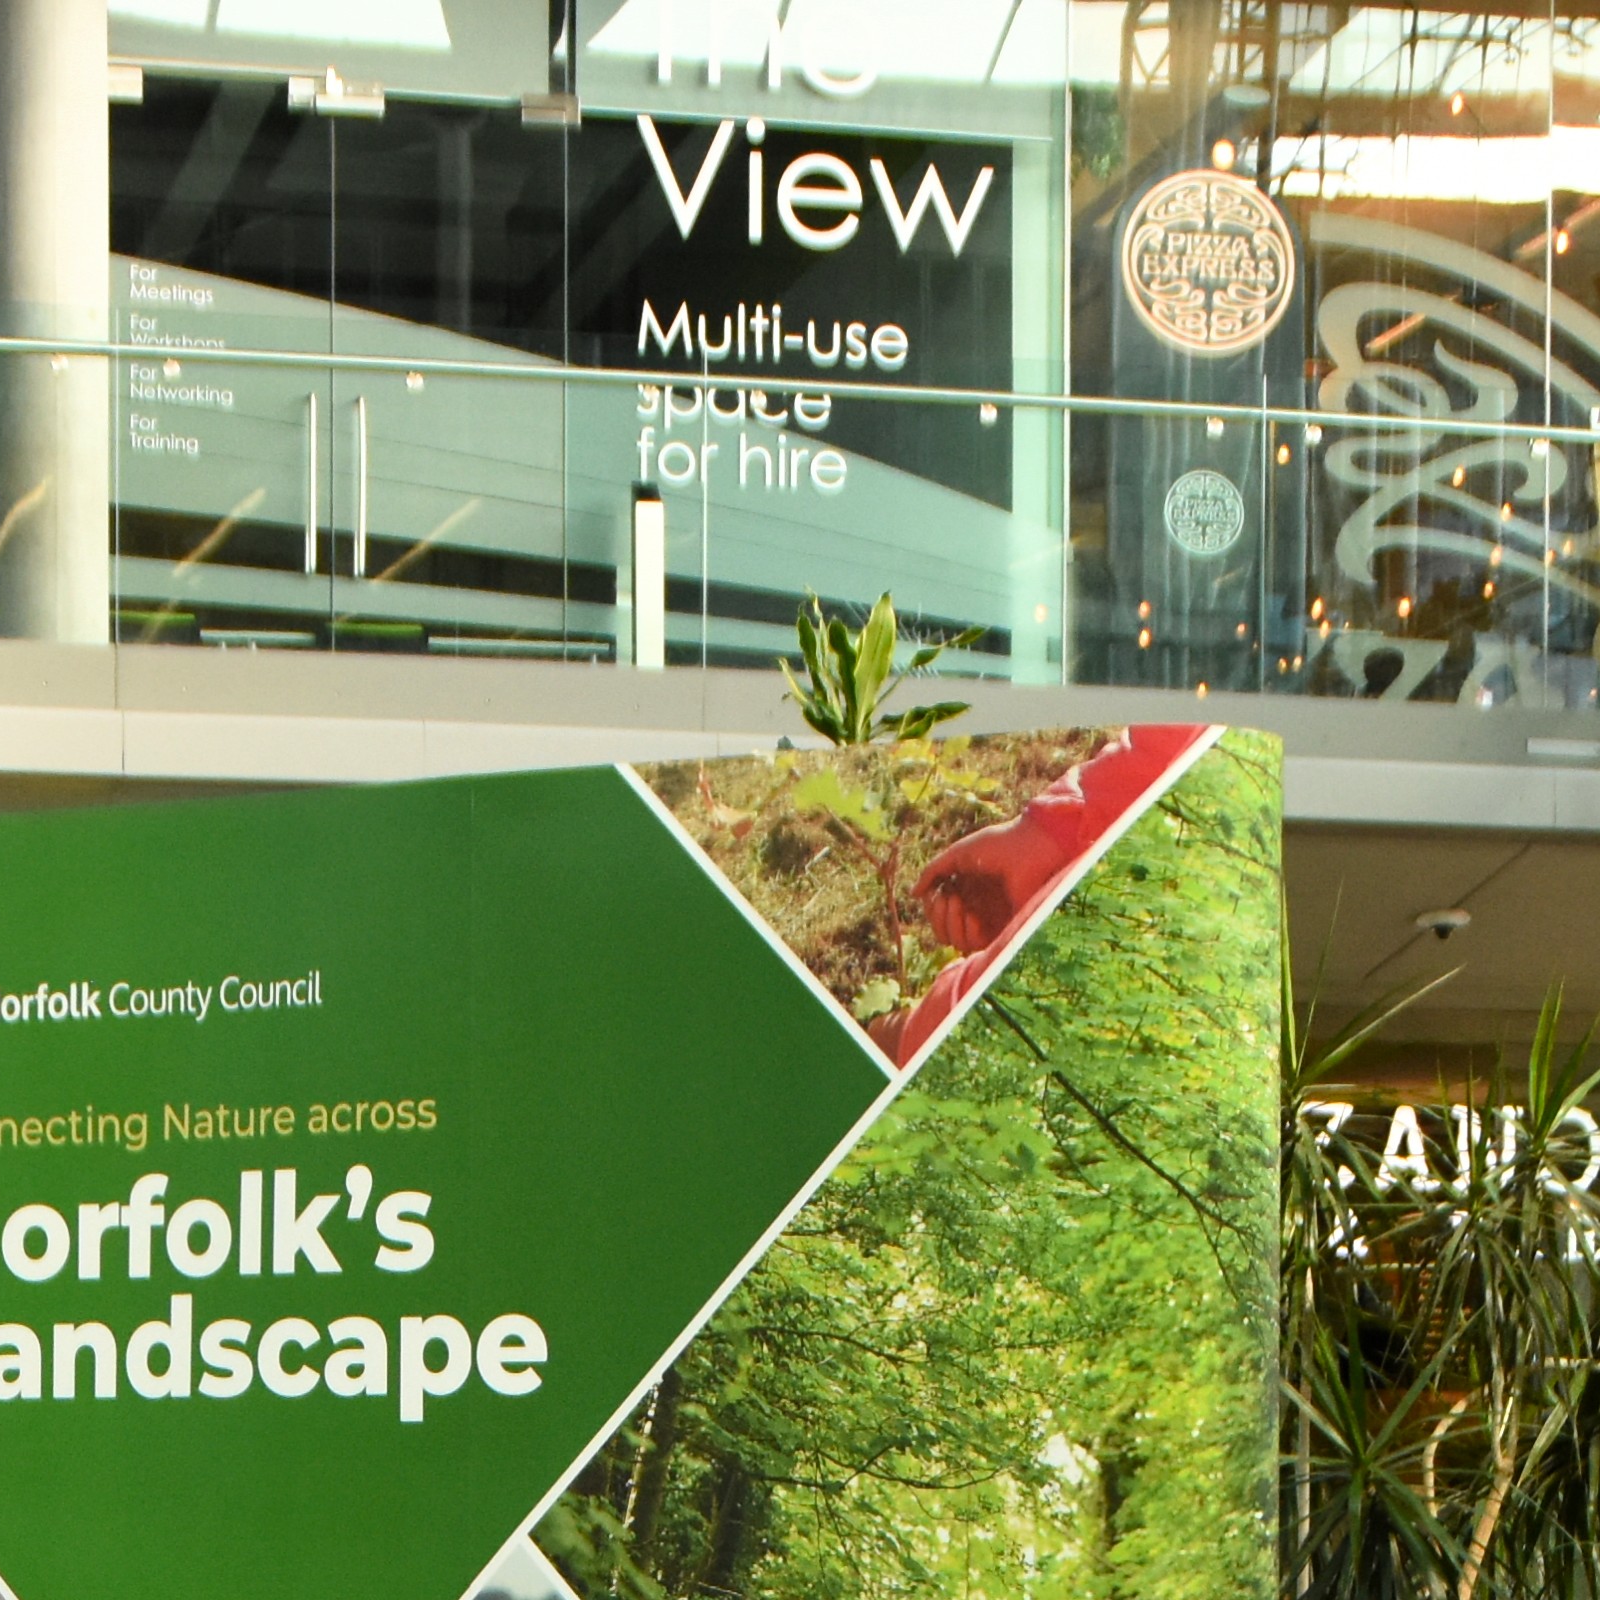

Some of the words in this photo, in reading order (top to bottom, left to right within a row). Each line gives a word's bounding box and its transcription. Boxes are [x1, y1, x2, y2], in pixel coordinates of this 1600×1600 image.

[637, 113, 996, 258] View
[1167, 231, 1251, 259] PIZZA
[129, 264, 158, 281] For
[1142, 254, 1275, 282] EXPRESS
[130, 284, 214, 306] Meetings
[129, 314, 158, 331] For
[637, 298, 910, 372] Multi-use
[129, 364, 158, 381] For
[130, 383, 234, 406] Networking
[129, 414, 158, 431] For
[130, 432, 200, 455] Training
[636, 426, 720, 484] for
[738, 432, 849, 494] hire
[108, 980, 212, 1022] County
[219, 970, 322, 1012] Council
[163, 1101, 295, 1142] Nature
[308, 1099, 438, 1133] across
